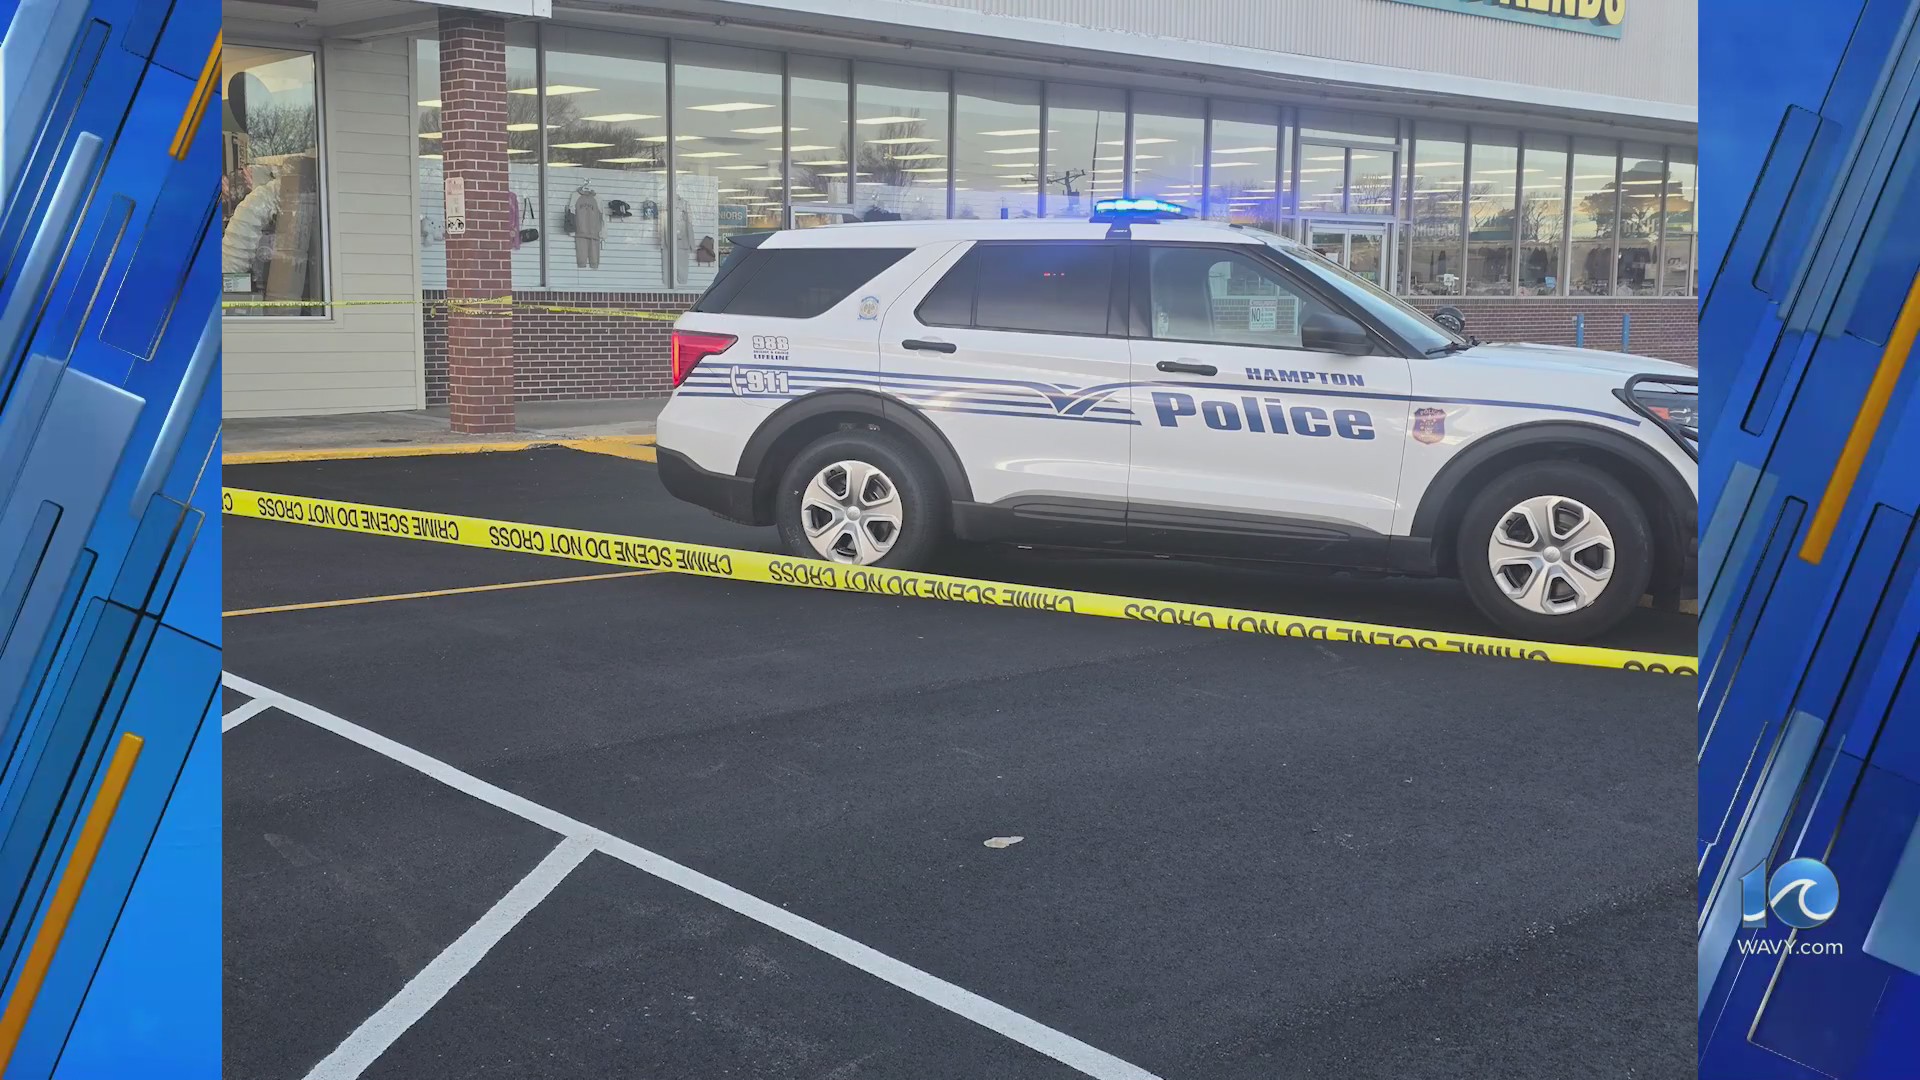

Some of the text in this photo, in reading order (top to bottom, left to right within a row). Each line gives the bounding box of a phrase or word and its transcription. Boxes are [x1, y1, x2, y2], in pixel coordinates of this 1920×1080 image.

[752, 335, 789, 351] 988
[746, 370, 789, 393] 911
[1245, 367, 1365, 387] HAMPTON
[1151, 391, 1376, 440] Police
[257, 497, 459, 541] CRIME SCENE DO NOT CROSS
[489, 526, 733, 576] CRIME SCENE DO NOT CROSS
[768, 560, 1077, 614] CRIME SCENE DO NOT CROSS
